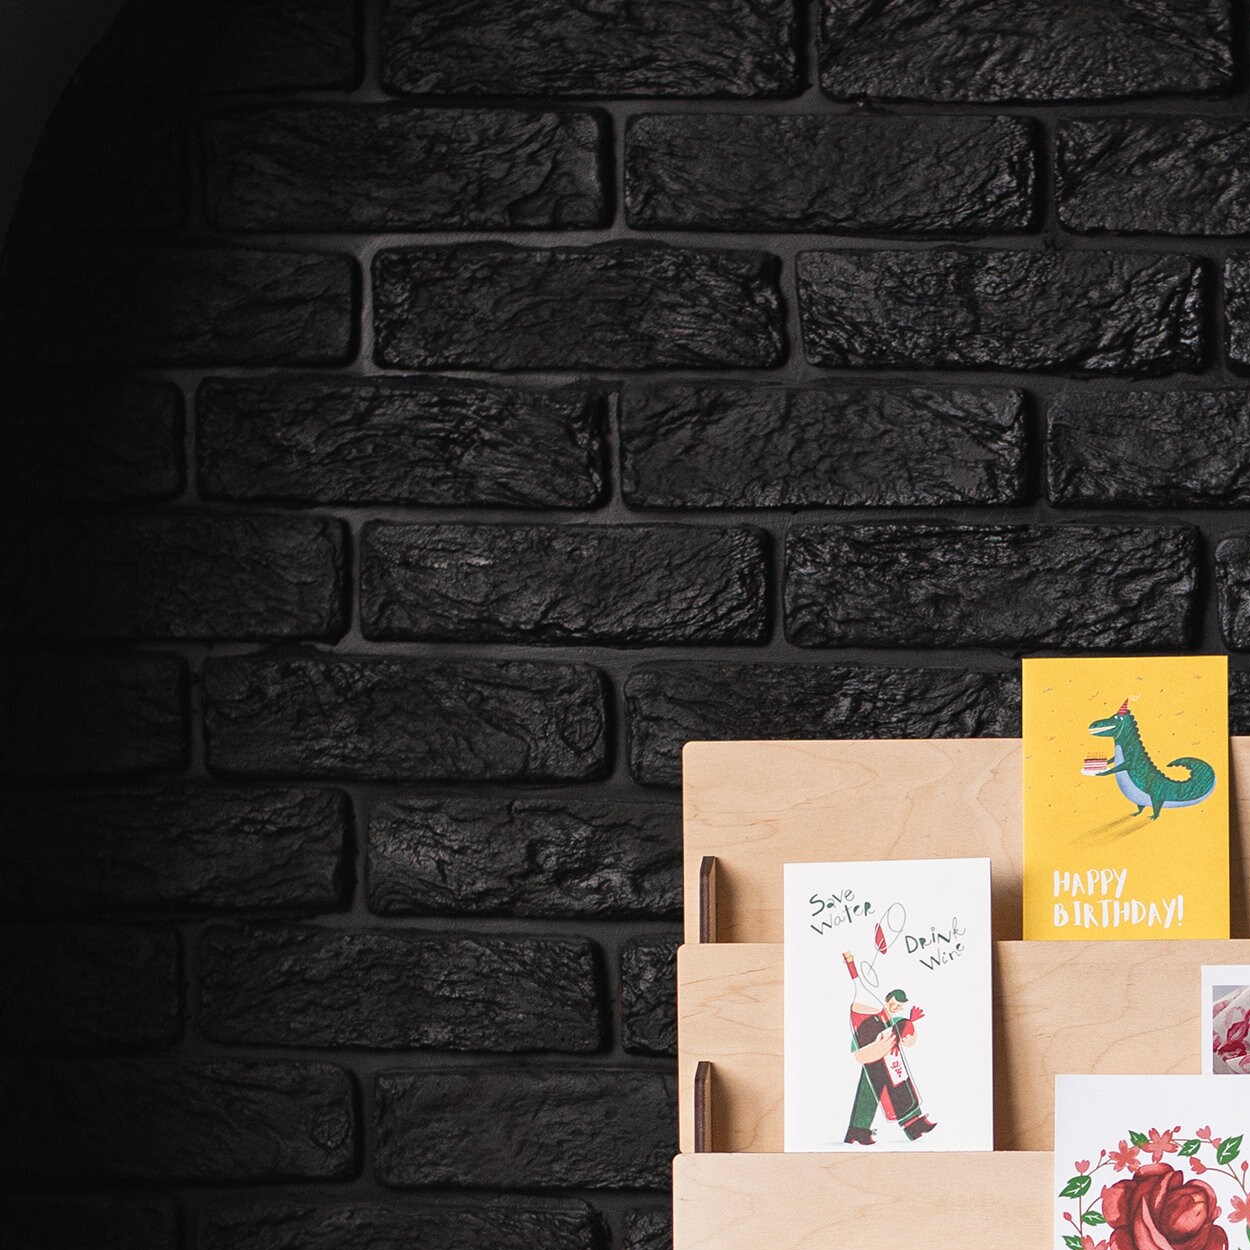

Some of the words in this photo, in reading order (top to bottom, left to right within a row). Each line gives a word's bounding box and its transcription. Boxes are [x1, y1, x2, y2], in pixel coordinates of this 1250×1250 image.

[1053, 868, 1128, 898] HAPPY
[808, 889, 856, 917] Save
[1053, 894, 1184, 929] BIRTHDAY!
